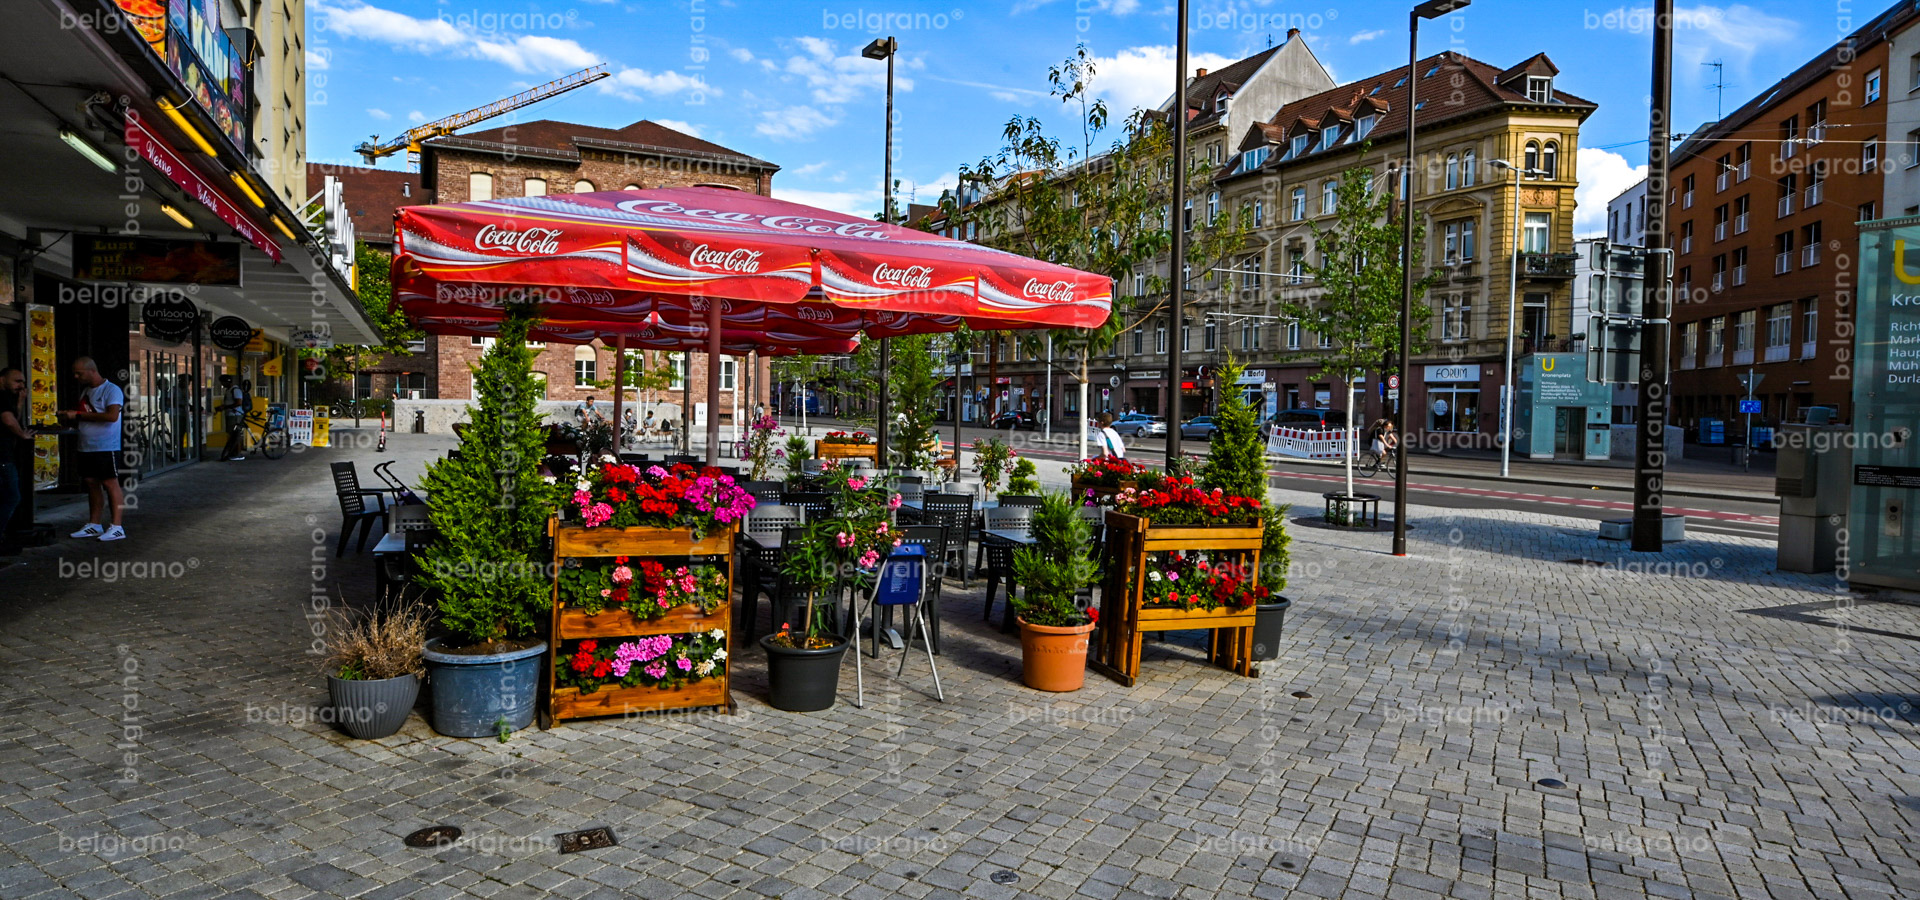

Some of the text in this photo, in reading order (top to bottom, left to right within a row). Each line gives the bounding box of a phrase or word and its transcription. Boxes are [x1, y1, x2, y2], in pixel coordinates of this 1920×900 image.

[146, 140, 172, 176] Weine
[95, 240, 136, 250] Lust
[94, 253, 122, 263] auf
[92, 266, 144, 277] Grill?
[1542, 358, 1555, 372] U
[1436, 368, 1468, 378] FORUM
